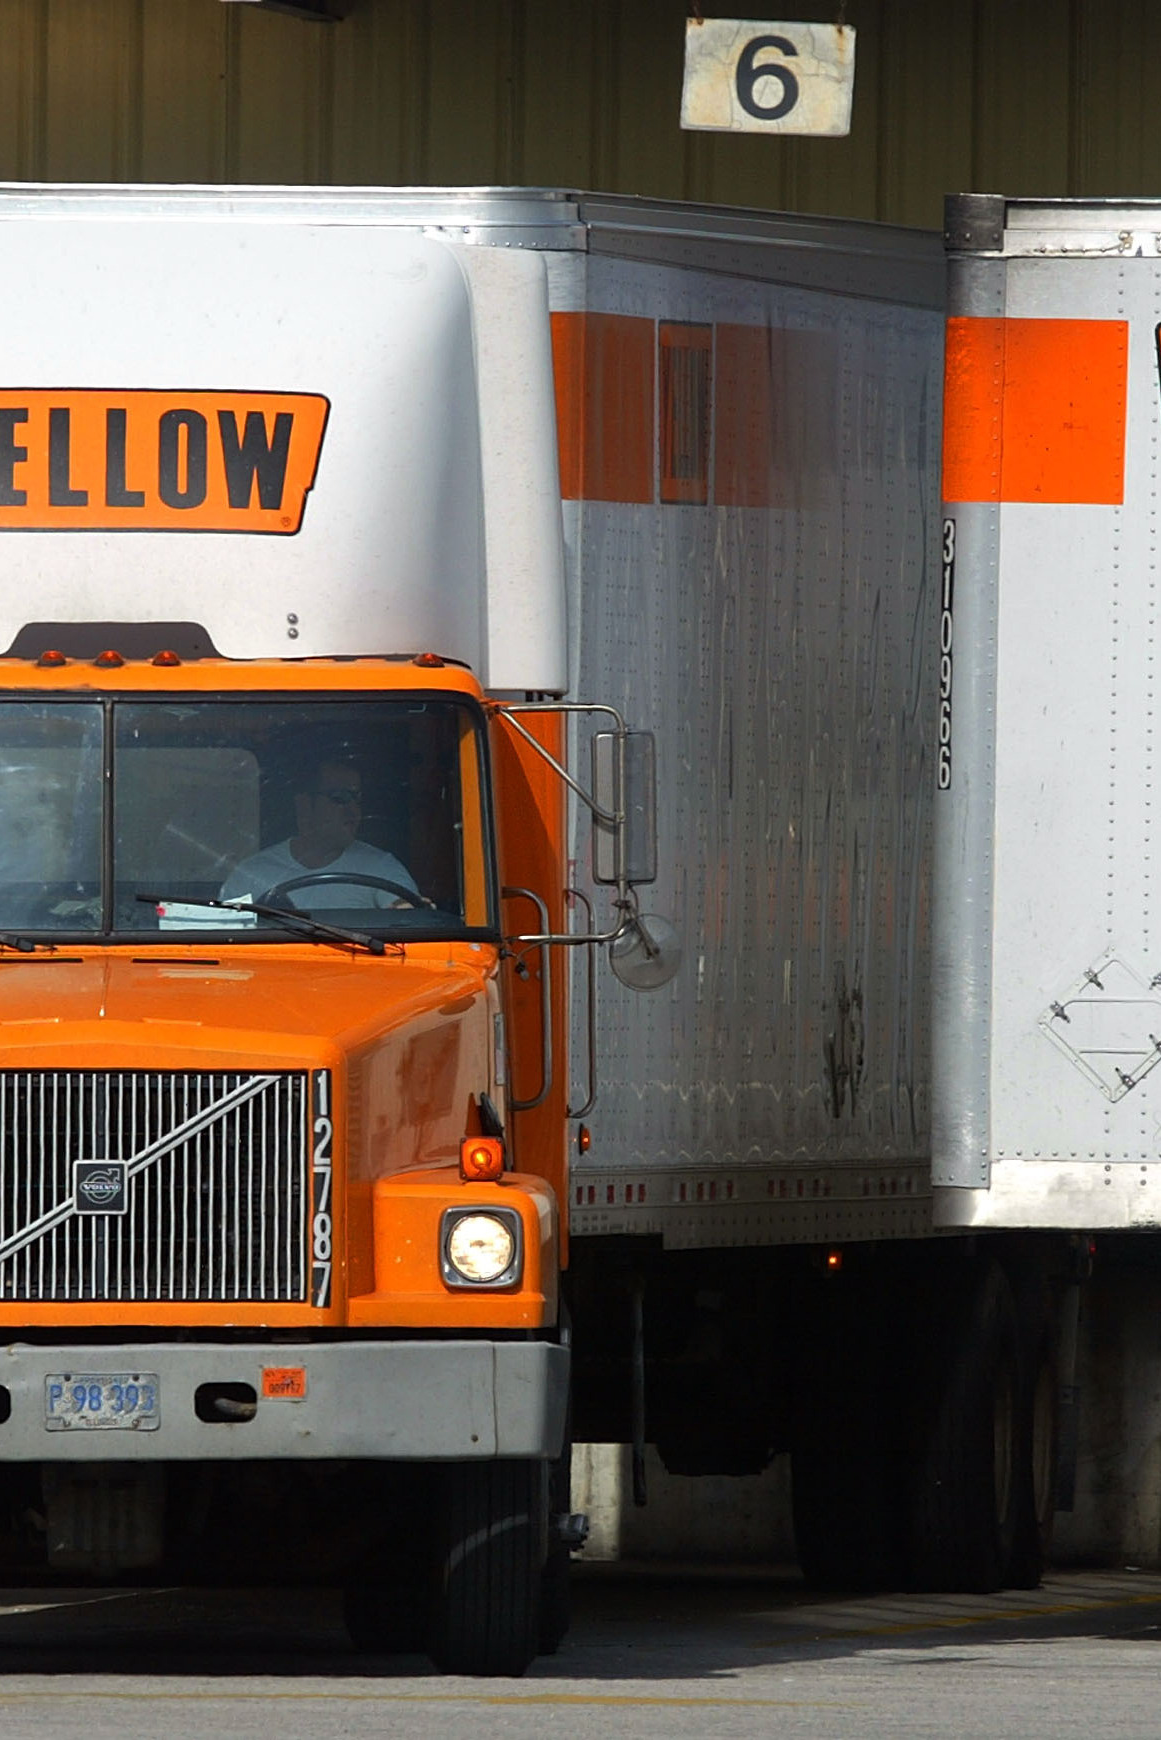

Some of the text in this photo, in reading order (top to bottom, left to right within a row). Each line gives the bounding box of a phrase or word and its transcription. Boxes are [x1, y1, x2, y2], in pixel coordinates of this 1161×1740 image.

[736, 35, 799, 120] 6
[938, 519, 956, 789] 310966
[312, 1069, 332, 1308] 12787
[49, 1385, 62, 1413] P
[73, 1384, 101, 1412] 98
